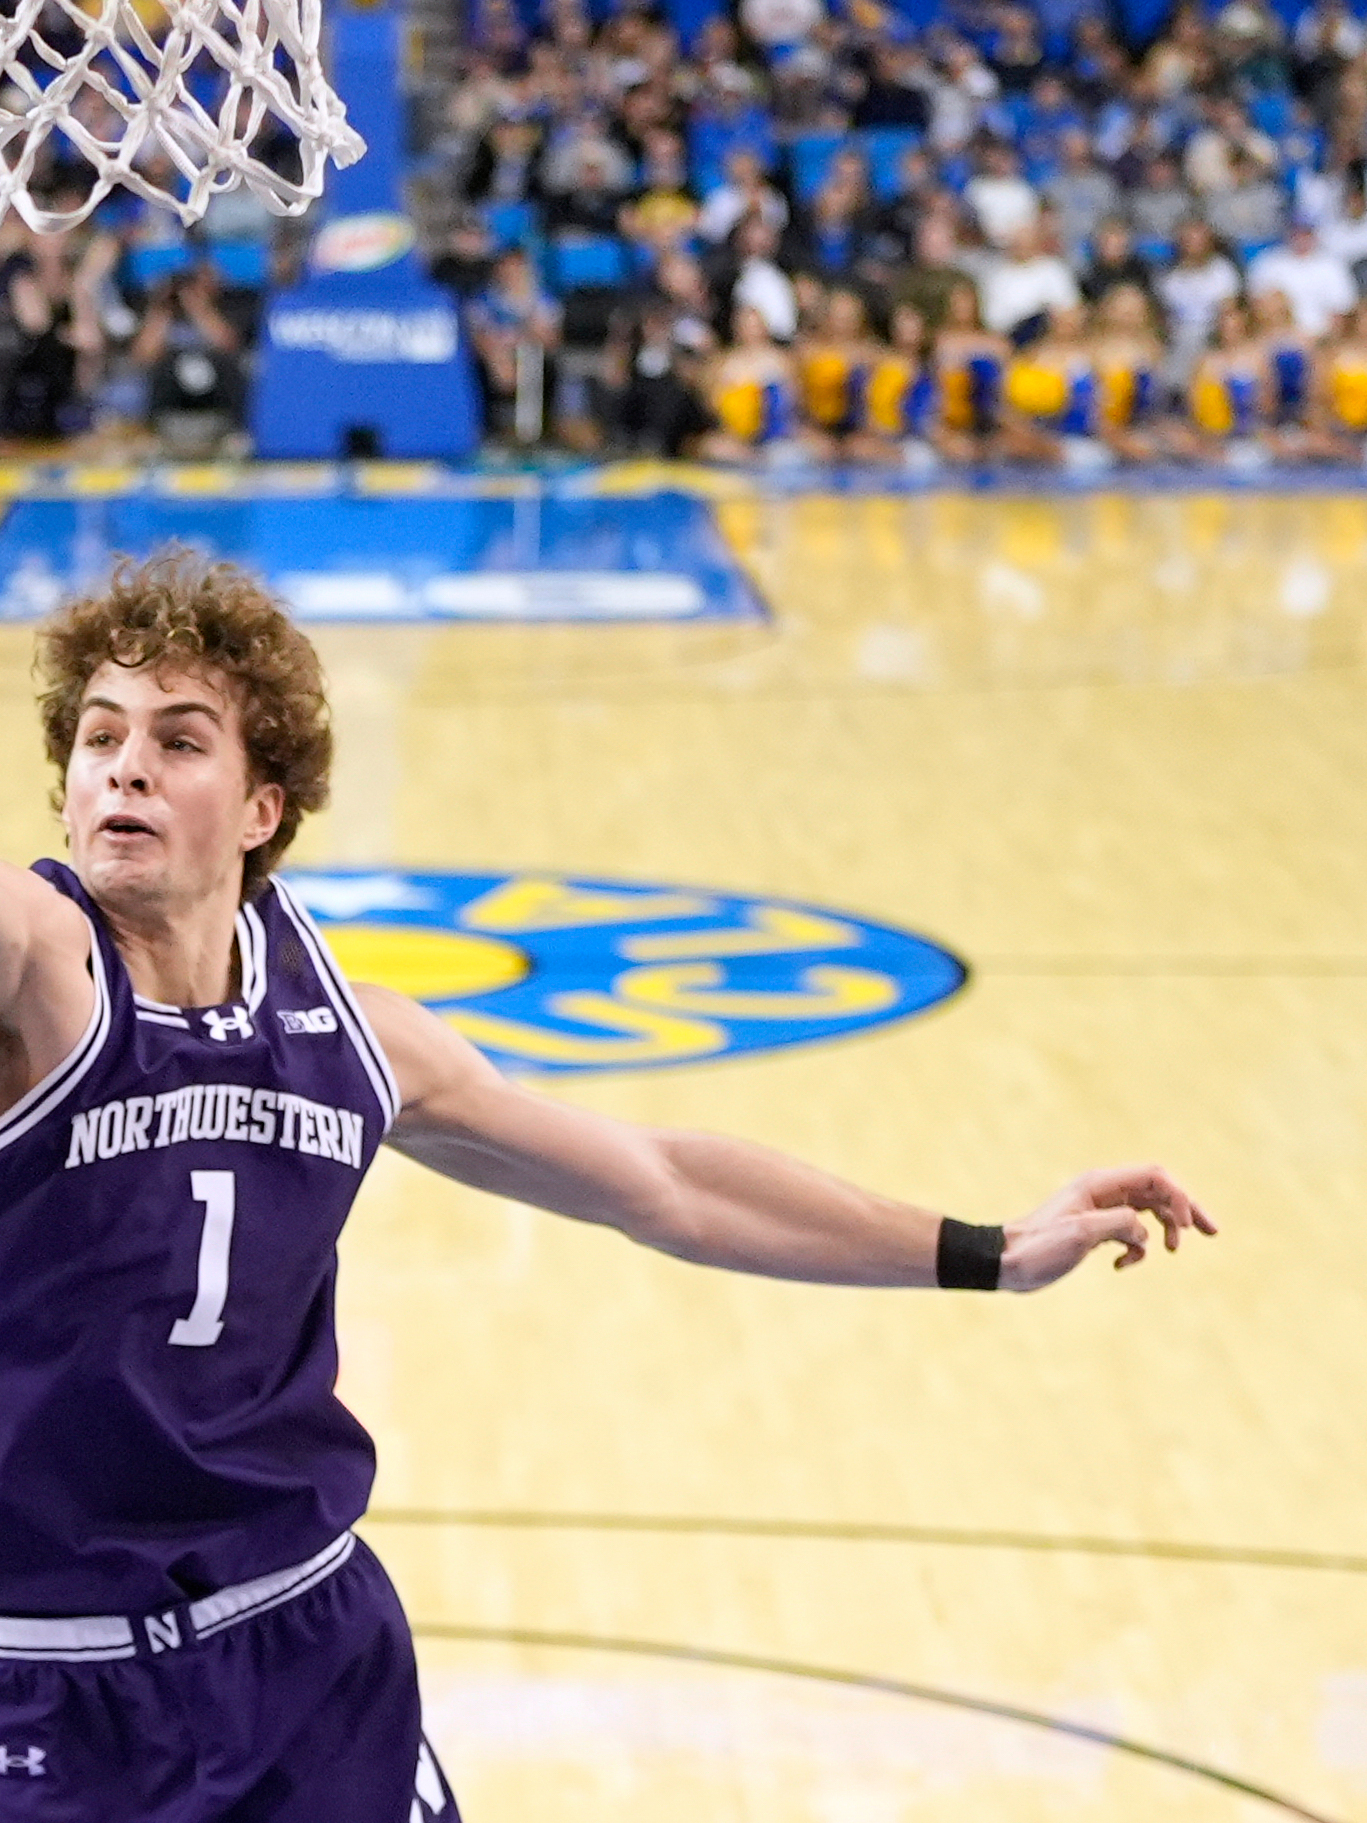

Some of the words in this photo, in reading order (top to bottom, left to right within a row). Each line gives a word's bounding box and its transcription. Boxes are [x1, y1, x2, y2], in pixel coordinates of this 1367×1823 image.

[64, 1084, 365, 1169] NORTHWESTERN
[167, 1169, 235, 1347] 1
[143, 1610, 181, 1654] N
